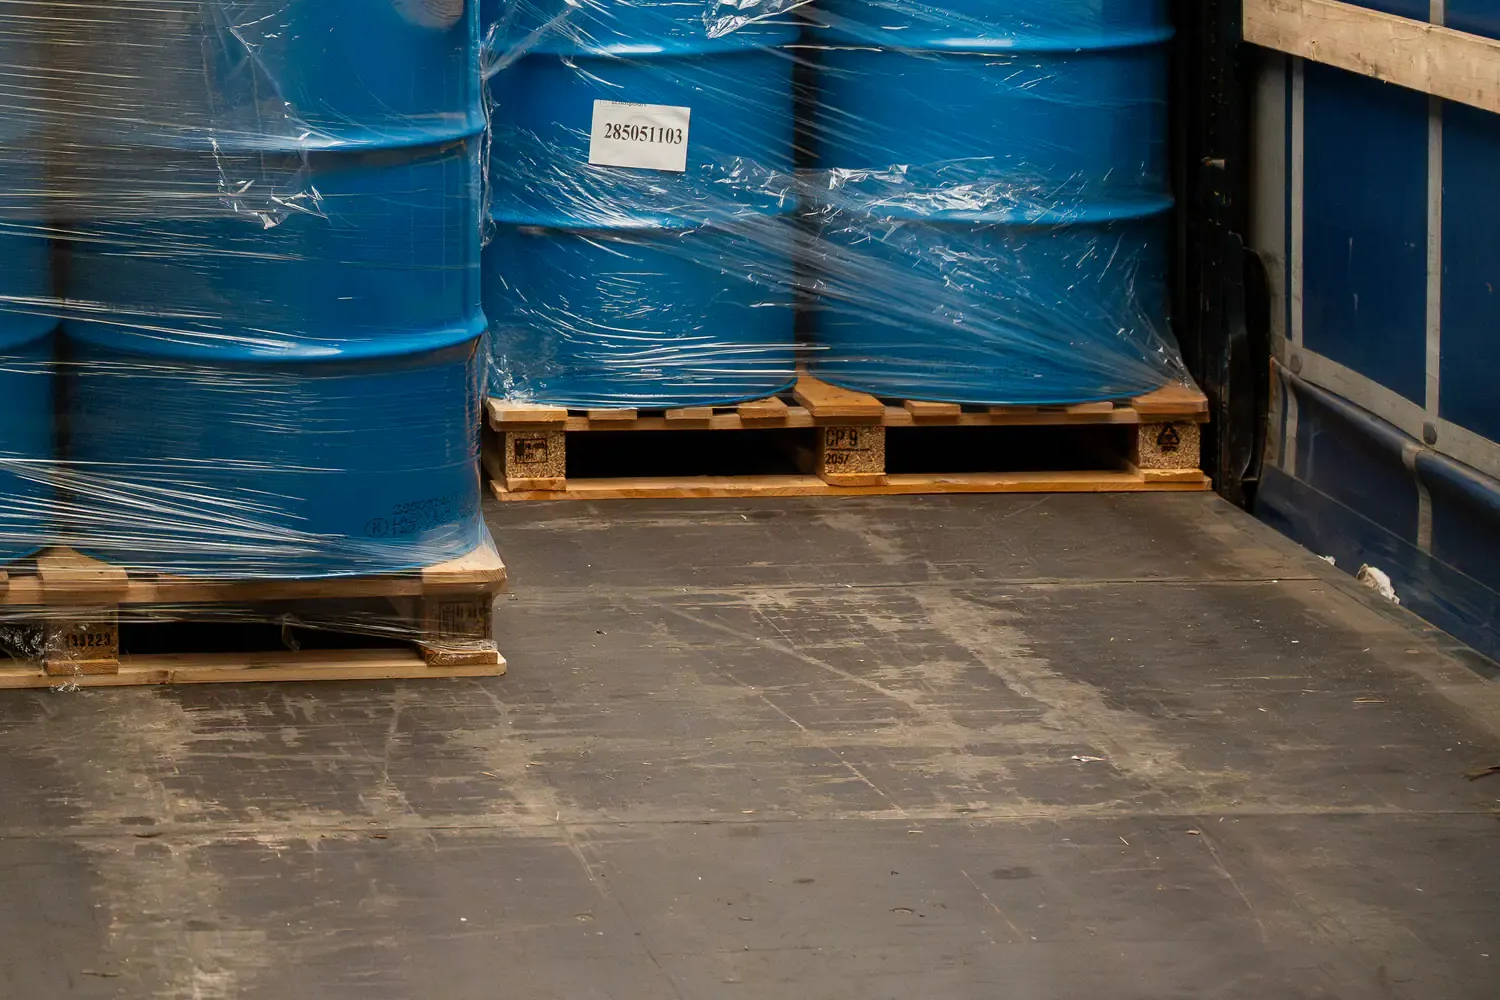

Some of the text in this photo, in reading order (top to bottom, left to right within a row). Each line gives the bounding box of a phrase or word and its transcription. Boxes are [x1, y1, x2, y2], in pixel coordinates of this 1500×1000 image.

[604, 122, 682, 144] 285051103
[826, 429, 858, 447] CP 9
[825, 453, 850, 465] 2057
